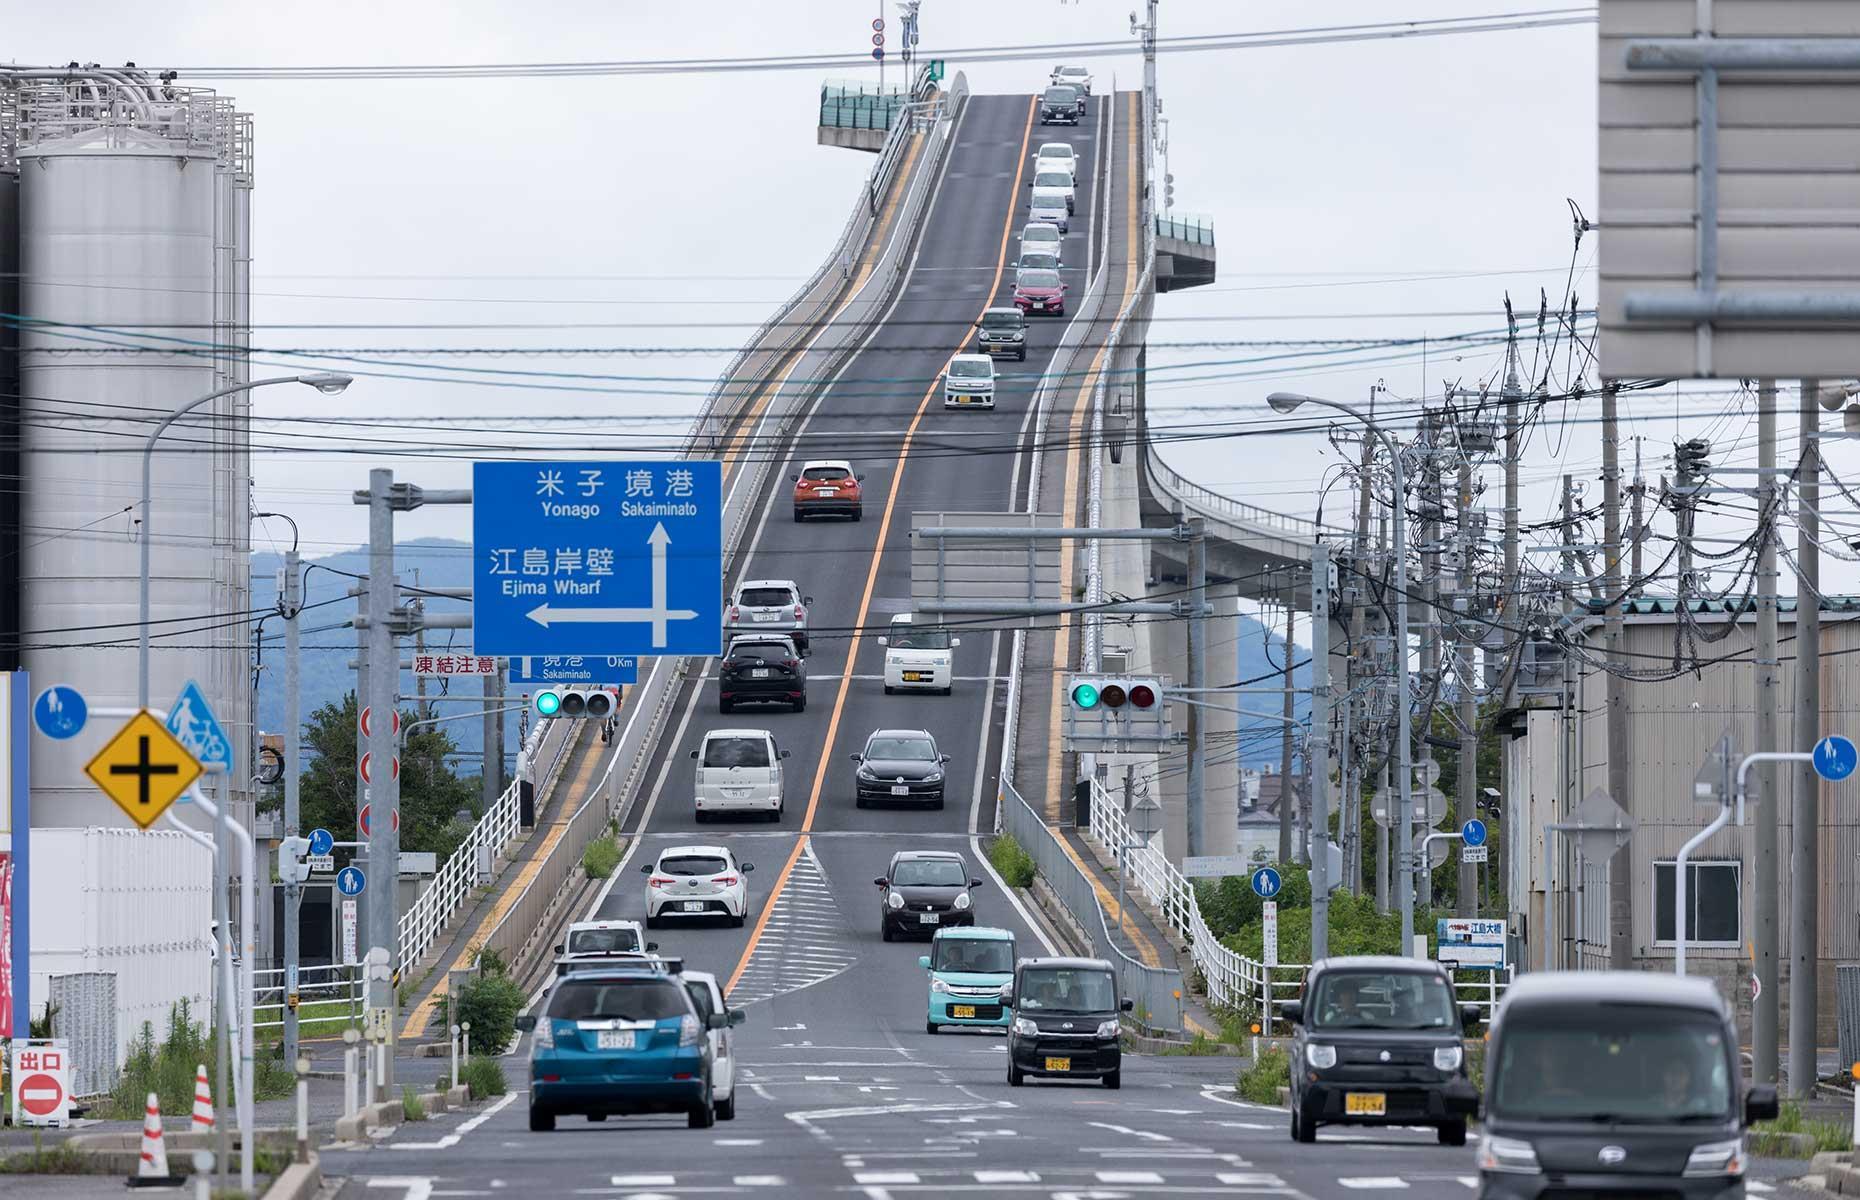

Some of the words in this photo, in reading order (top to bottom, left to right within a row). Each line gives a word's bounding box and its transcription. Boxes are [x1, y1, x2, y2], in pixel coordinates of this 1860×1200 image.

[536, 469, 605, 498] 米子
[624, 469, 694, 498] 境港
[541, 502, 600, 519] Yonago
[621, 501, 697, 516] Sakaiminato
[489, 547, 614, 576] 江島岸壁
[502, 580, 547, 597] Ejima
[553, 580, 601, 595] Wharf
[414, 656, 495, 674] 凍結注意
[543, 669, 592, 680] Sakaiminato
[1471, 922, 1502, 934] 江島大橋
[20, 1052, 61, 1071] 出口
